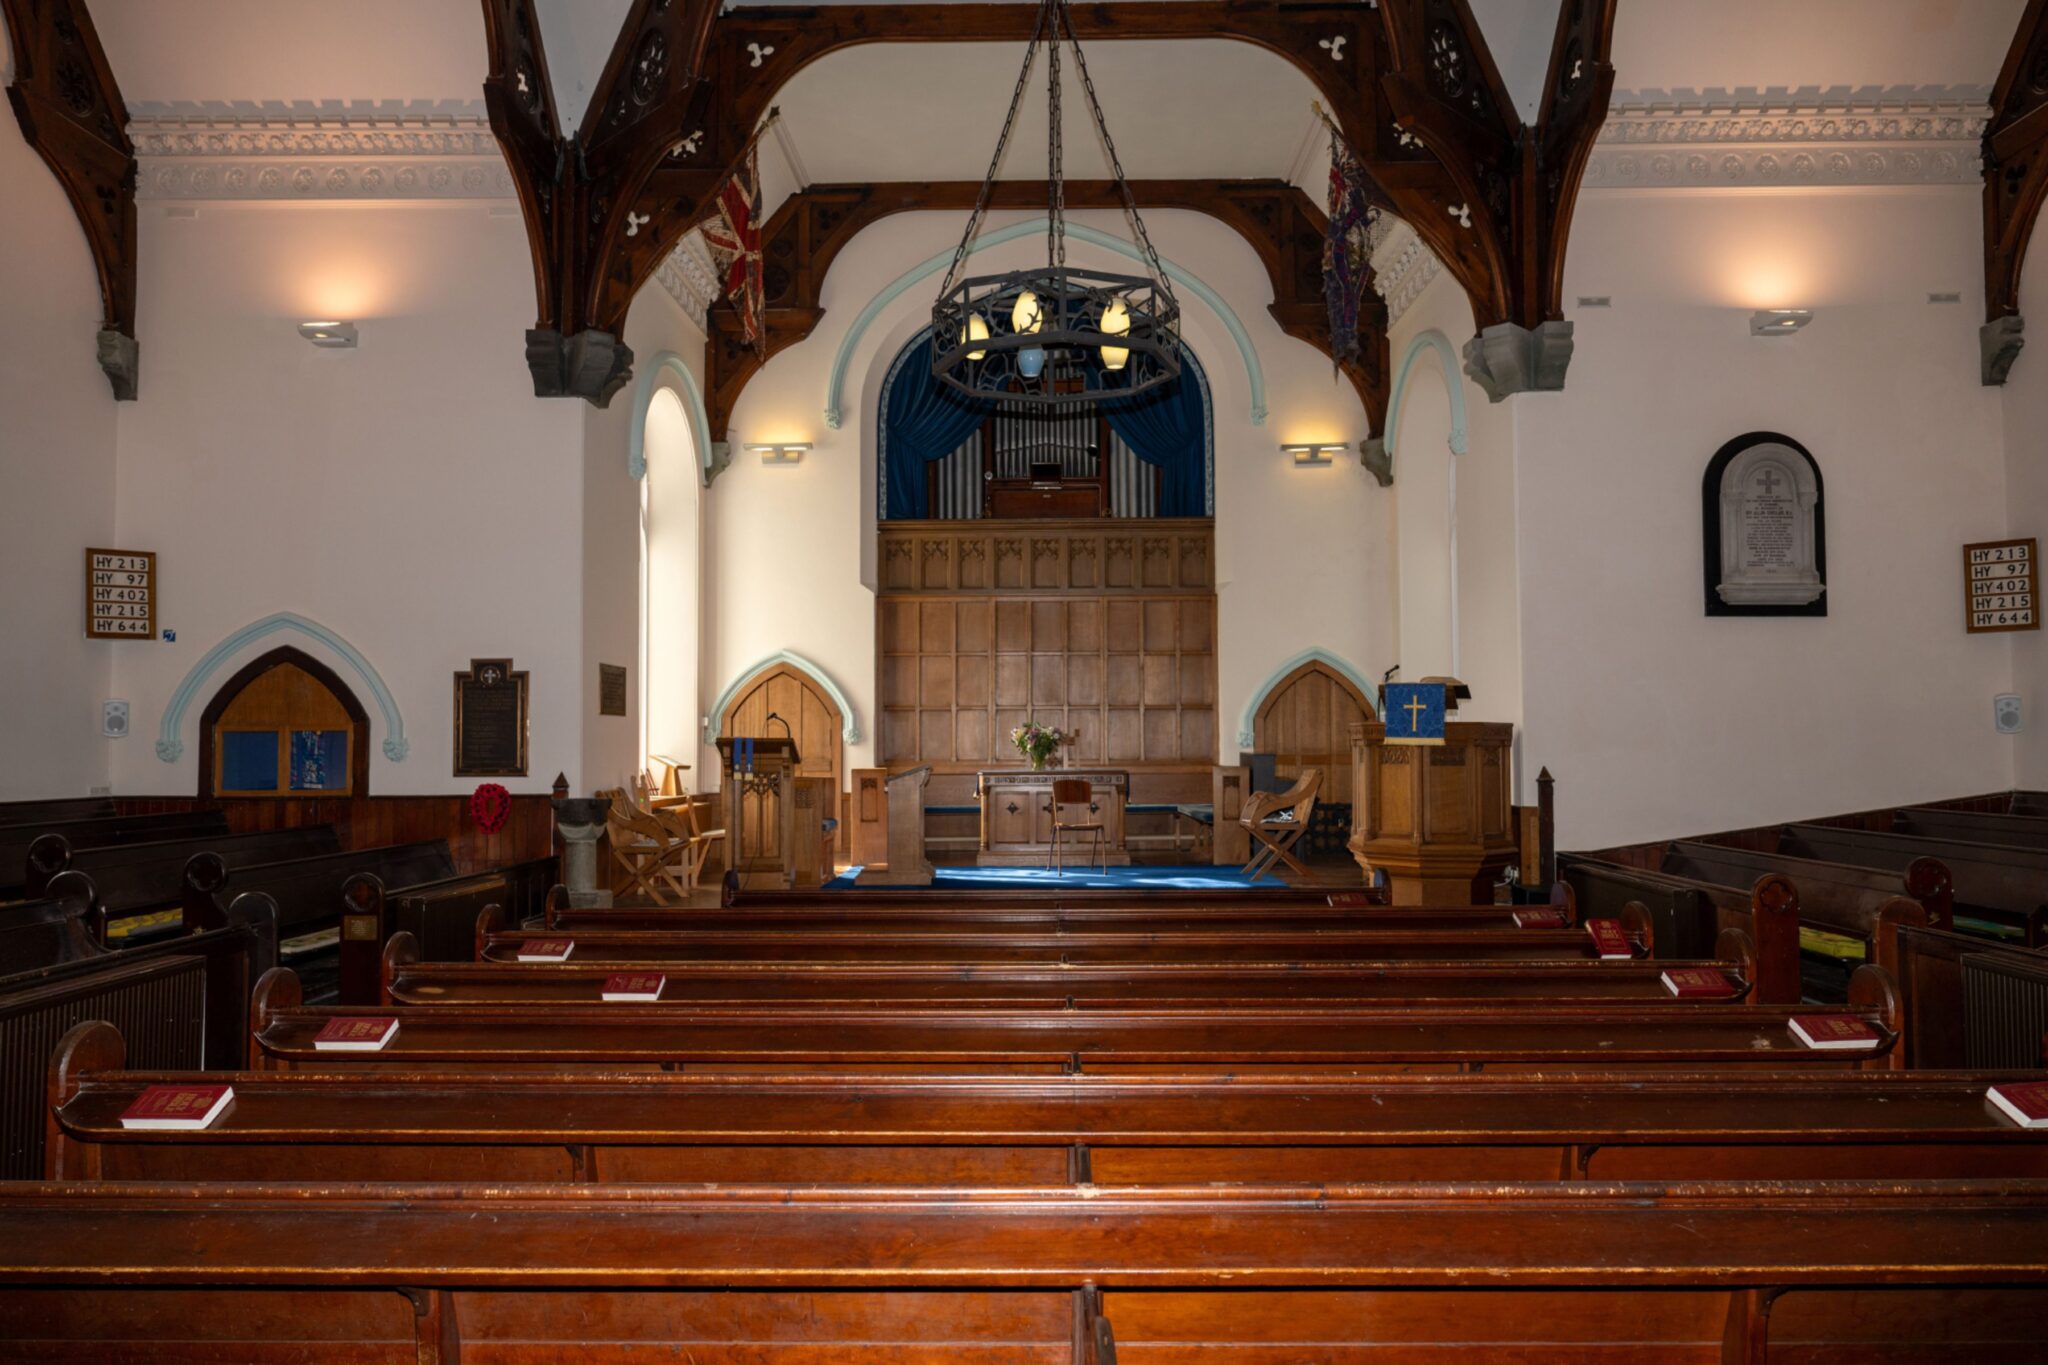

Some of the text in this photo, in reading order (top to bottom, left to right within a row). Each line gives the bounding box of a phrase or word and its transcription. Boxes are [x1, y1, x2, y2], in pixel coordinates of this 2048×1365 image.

[1974, 551, 1990, 561] HY
[96, 556, 112, 567] HY
[1974, 566, 1991, 577] HY
[95, 573, 113, 583] HY
[1974, 582, 1993, 593] HY
[96, 589, 112, 599] HY
[1976, 598, 1992, 609] HY
[96, 605, 113, 615] HY
[1977, 614, 1993, 624] HY
[97, 620, 113, 631] HY
